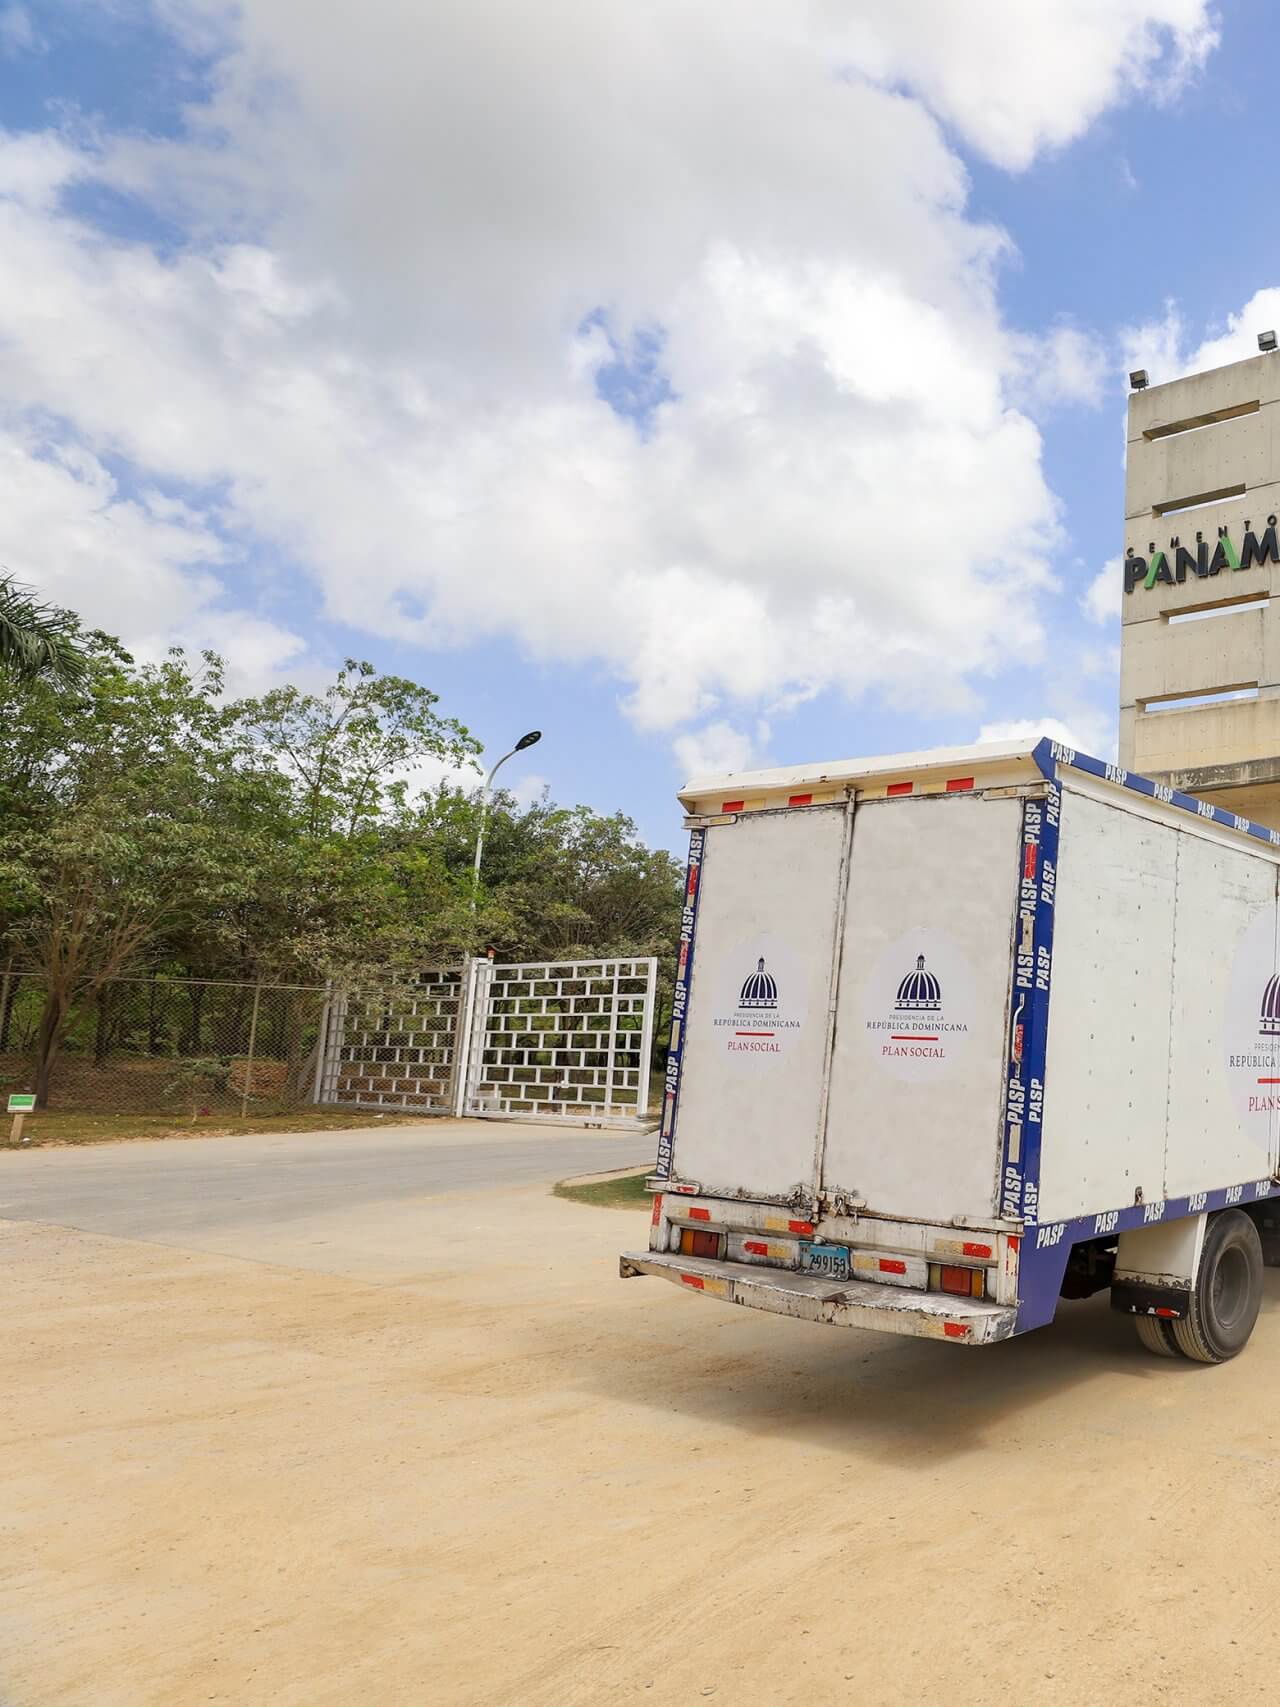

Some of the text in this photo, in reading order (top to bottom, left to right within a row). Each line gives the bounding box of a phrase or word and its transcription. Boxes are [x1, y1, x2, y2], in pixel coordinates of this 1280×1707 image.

[1126, 514, 1277, 558] CEMENTO
[1050, 741, 1075, 766] PASP
[1105, 764, 1127, 786] PASP
[1153, 783, 1174, 803] PASP
[1197, 800, 1215, 820] PASP
[1234, 815, 1250, 834] PASP
[1024, 803, 1042, 845] PASP
[1019, 877, 1037, 921] PASP
[656, 830, 704, 1177] PASP PASP PASP PASP PASP
[752, 1020, 800, 1028] DOMINICANA
[1024, 783, 1062, 1227] PASP PASP PASP PASP PASP
[727, 1041, 781, 1052] PLAN SOCIAL
[912, 1022, 968, 1032] DOMINICANA
[882, 1046, 945, 1058] PLAN SOCIAL
[1007, 1078, 1025, 1124] PASP
[1248, 1096, 1275, 1111] PLAN
[1003, 1166, 1023, 1217] PASP
[1036, 1223, 1065, 1249] PASP
[1094, 1211, 1119, 1234] PASP
[1143, 1201, 1166, 1223] PASP
[1188, 1193, 1208, 1213] PASP
[1225, 1186, 1243, 1204] PASP
[1255, 1180, 1271, 1198] PASP
